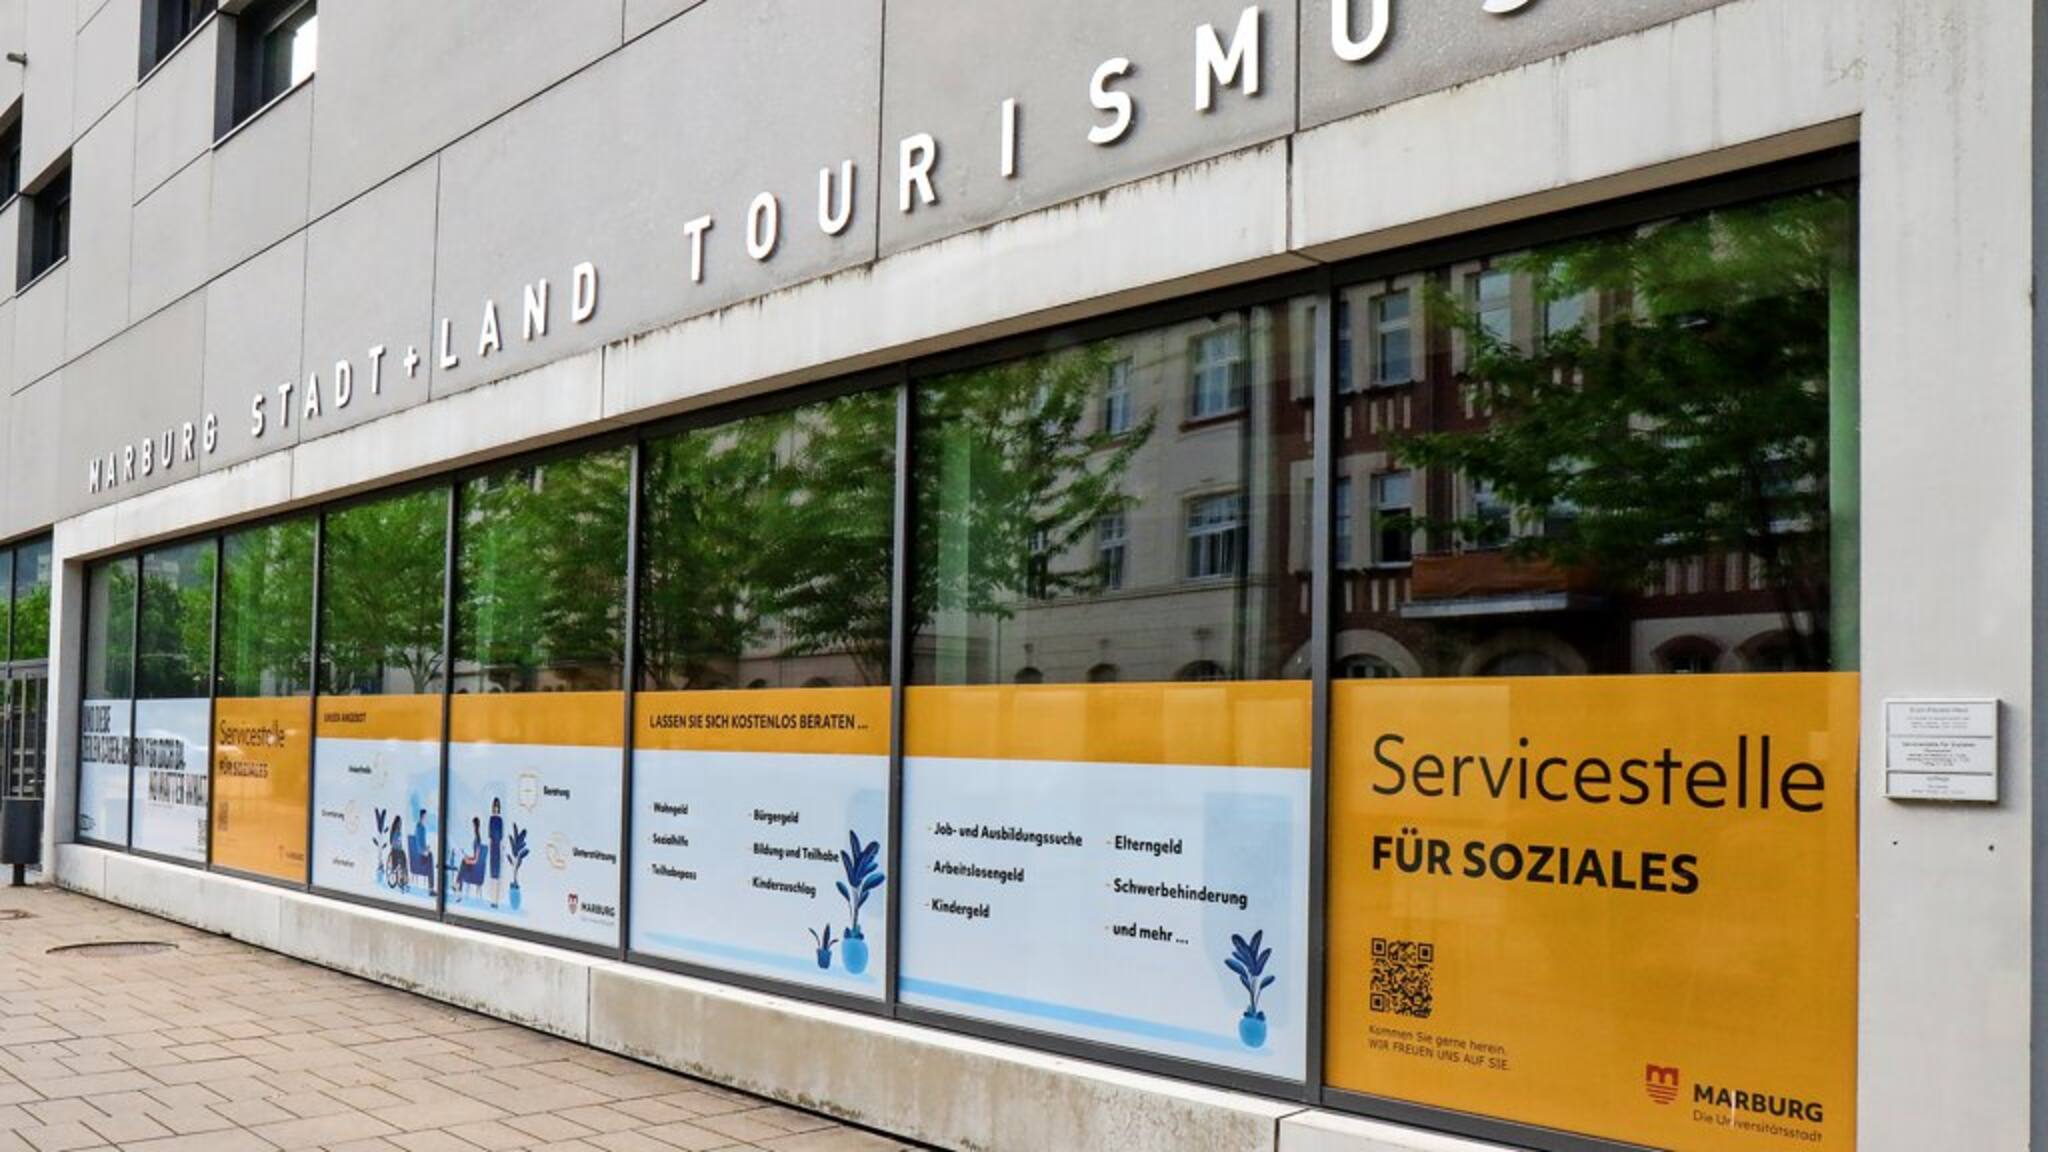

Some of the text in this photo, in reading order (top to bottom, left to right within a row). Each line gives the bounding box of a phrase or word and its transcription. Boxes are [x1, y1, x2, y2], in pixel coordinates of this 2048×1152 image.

[88, 0, 1531, 493] MARBURG STADT+LAND TOURISMU
[650, 716, 687, 728] LASSEN
[688, 715, 702, 728] SIE
[704, 715, 729, 728] SICH
[731, 715, 797, 729] KOSTENLOS
[799, 714, 855, 729] BERATEN
[219, 720, 285, 748] Servicestelle
[1372, 733, 1825, 812] Servicestelle
[653, 802, 689, 817] Wohngeld
[753, 809, 799, 826] Bürgergeld
[652, 832, 689, 847] Sozialhilfe
[934, 822, 1083, 847] Job- und Ausbildungssuche
[1114, 834, 1183, 855] Elterngeld
[753, 843, 840, 863] Bildung und Teilhabe
[1372, 827, 1699, 895] FÜR SOZIALES
[651, 864, 697, 881] Teilhabepass
[933, 860, 1025, 883] Arbeitslosengeld
[752, 876, 817, 898] Kinderzuschlag
[1113, 878, 1248, 910] Schwerbehinderung
[581, 902, 616, 917] MARBURG
[931, 899, 991, 919] Kindergeld
[1112, 923, 1137, 938] und
[1138, 928, 1173, 942] mehr
[1368, 1024, 1413, 1040] Kommen
[1415, 1031, 1433, 1045] Sie
[1434, 1035, 1468, 1050] gerne
[1367, 1038, 1390, 1050] WIR
[1392, 1041, 1434, 1058] FREUEN
[1436, 1049, 1461, 1063] UNS
[1462, 1053, 1487, 1067] AUF
[1693, 1083, 1824, 1123] MARBURG
[1693, 1109, 1714, 1123] Die
